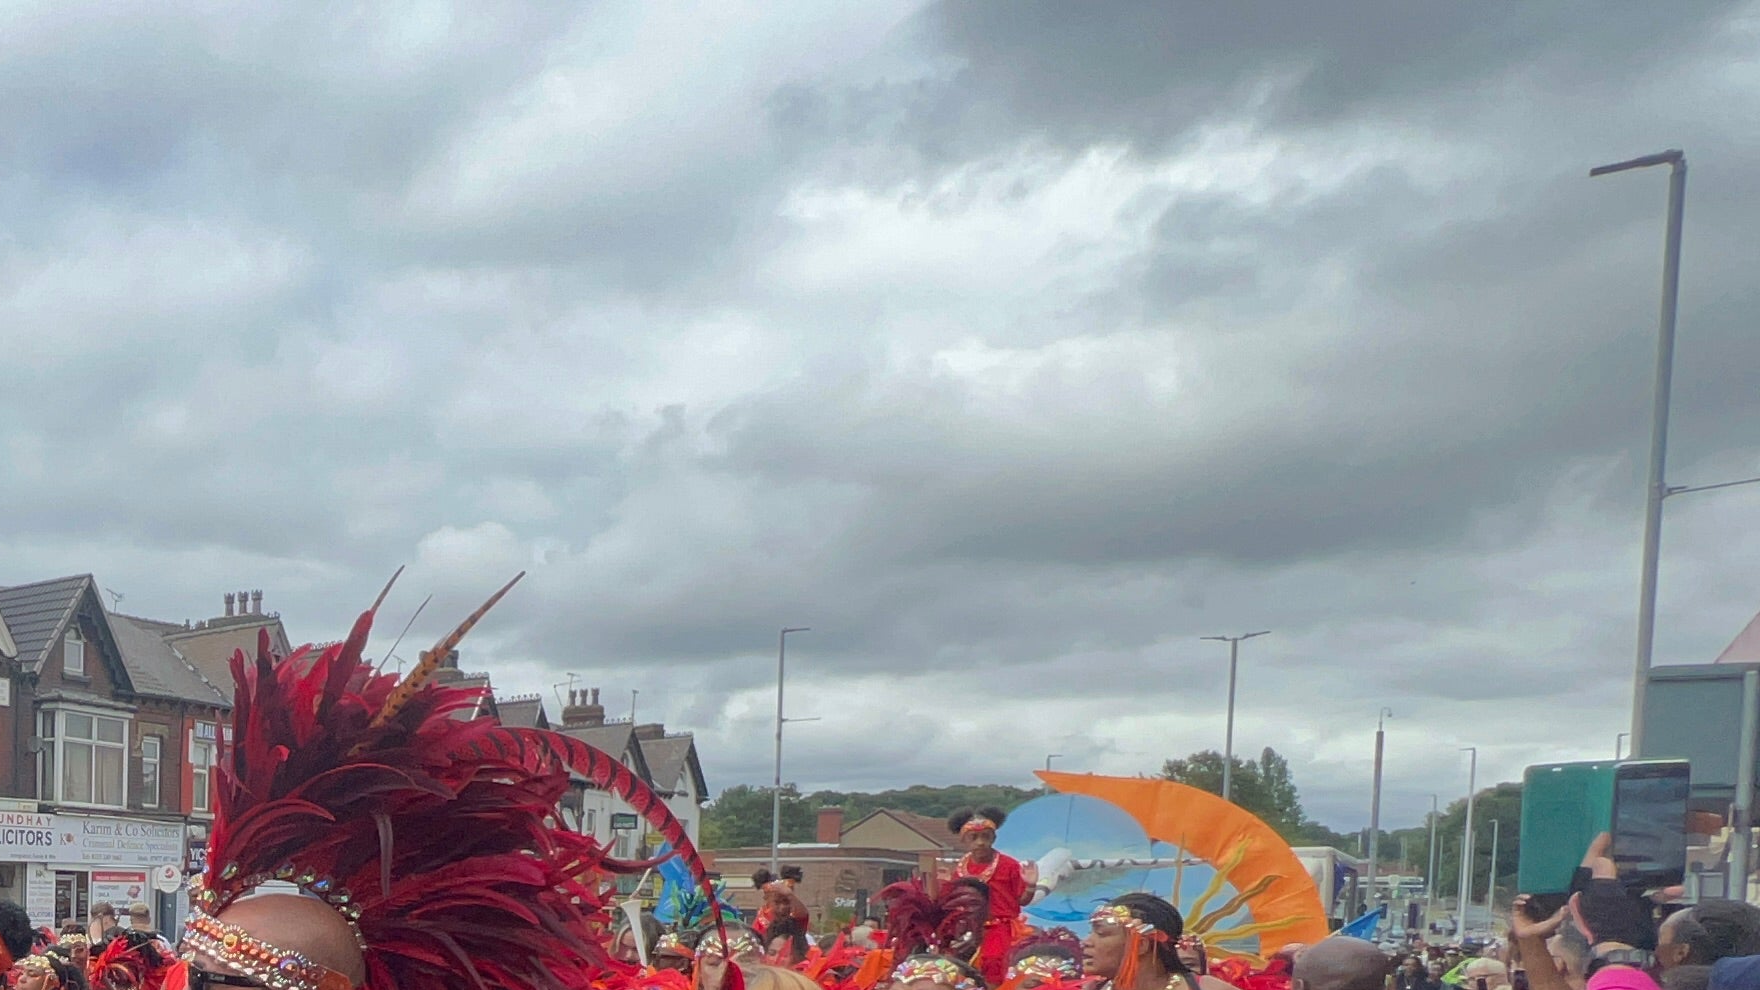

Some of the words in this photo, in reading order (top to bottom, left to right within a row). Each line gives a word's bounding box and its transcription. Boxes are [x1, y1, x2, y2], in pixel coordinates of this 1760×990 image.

[82, 820, 112, 836] Karim
[114, 823, 123, 837] &
[125, 824, 138, 838] Co
[140, 825, 180, 839] Solicitors
